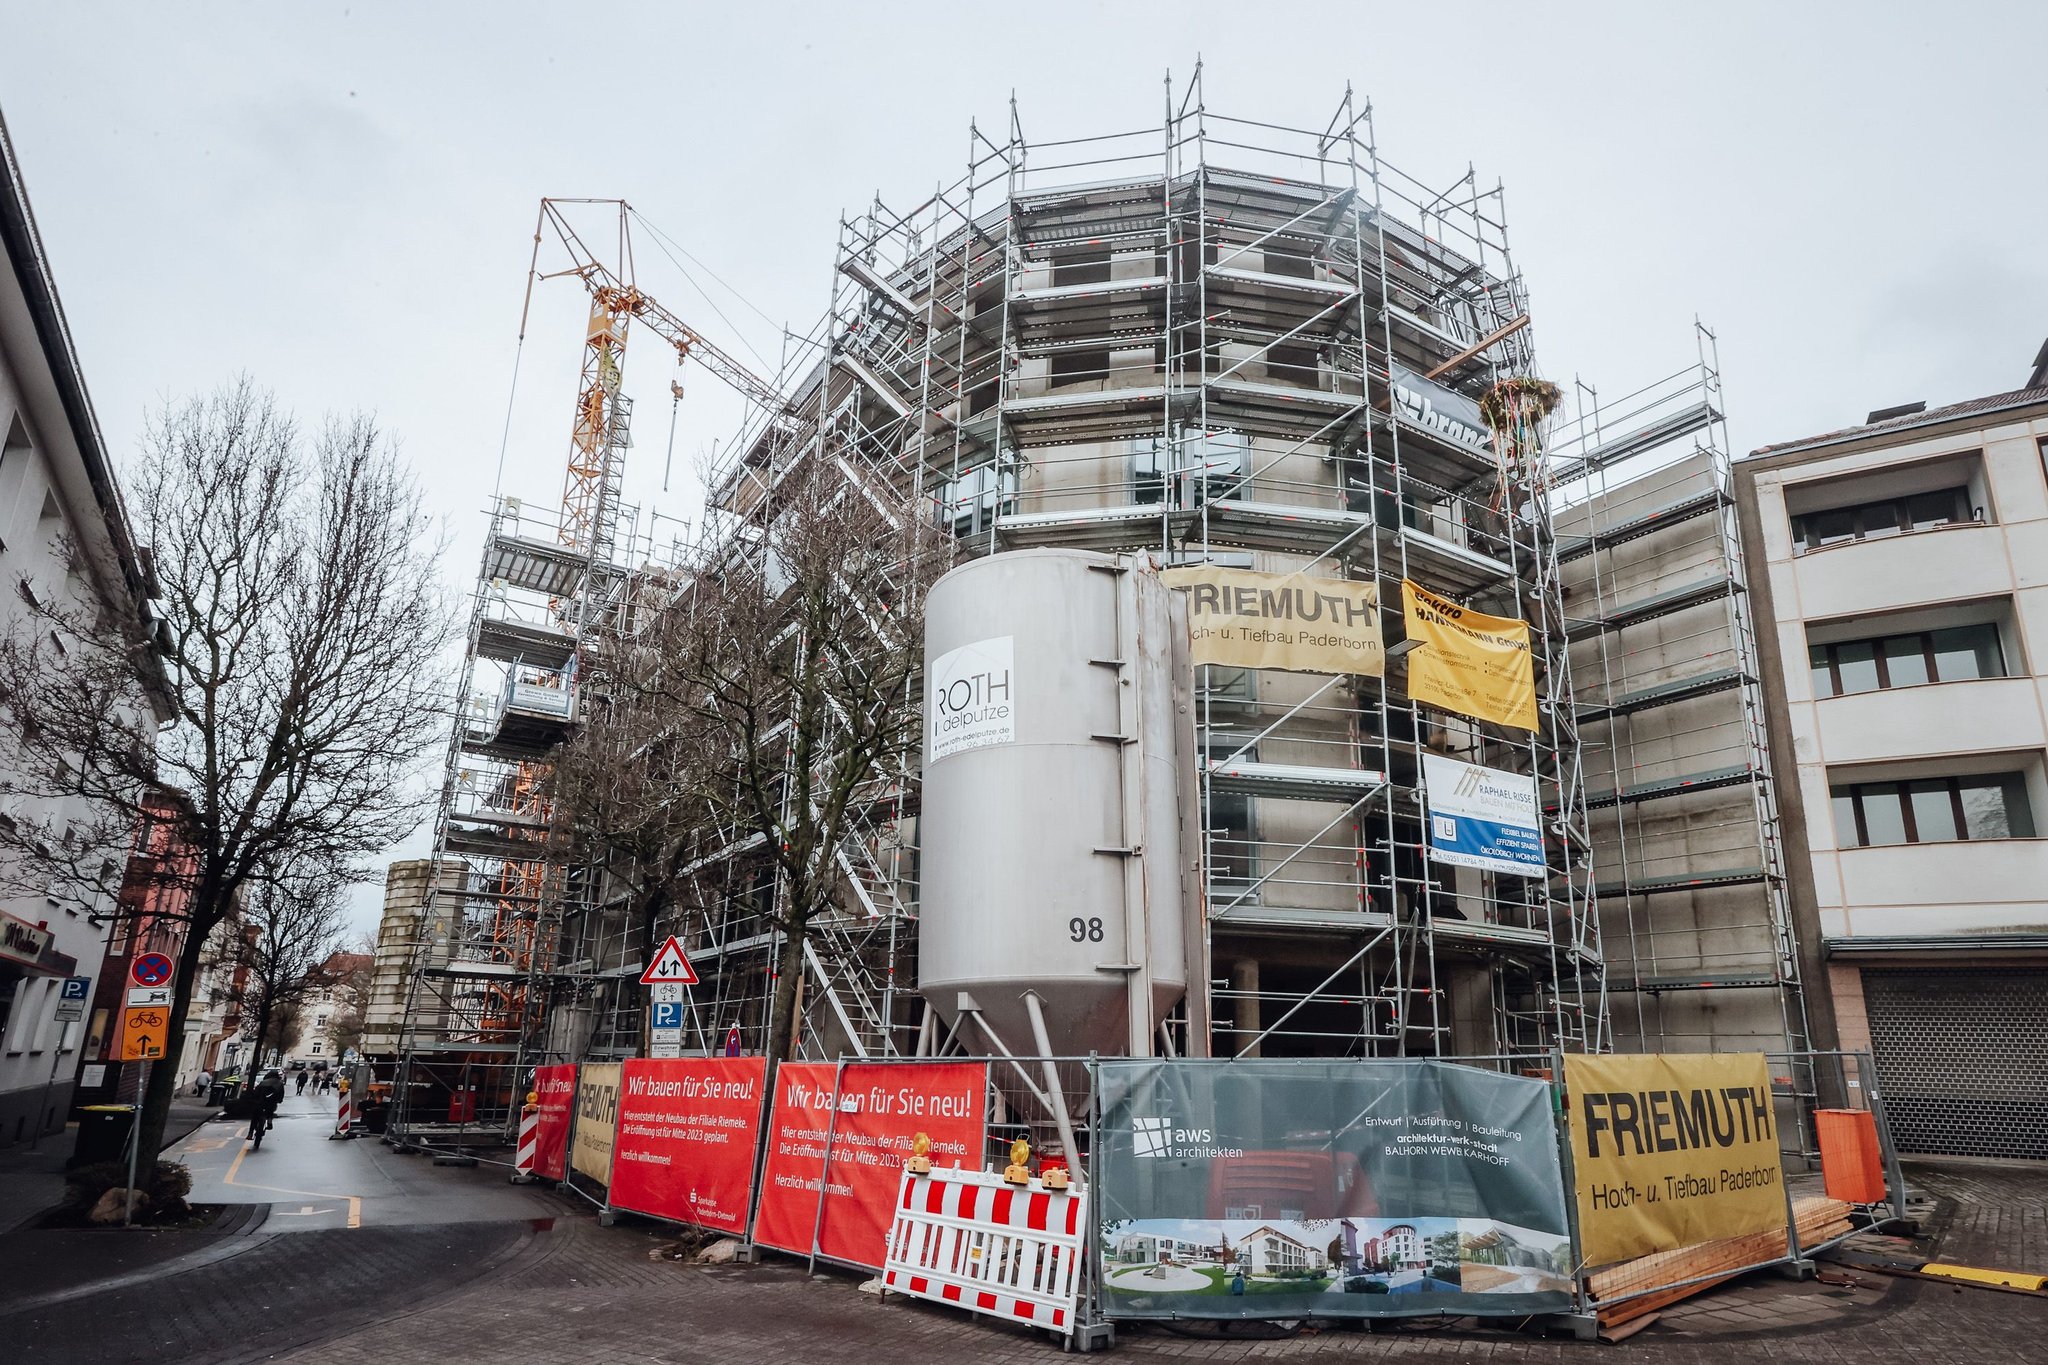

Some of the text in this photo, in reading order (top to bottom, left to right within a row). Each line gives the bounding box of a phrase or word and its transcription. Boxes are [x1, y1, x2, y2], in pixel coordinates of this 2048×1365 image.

[1174, 583, 1373, 627] RIEMUTH
[1221, 629, 1234, 640] u.
[1239, 627, 1293, 645] Tiefbau
[1299, 631, 1377, 651] Paderborn
[1479, 784, 1532, 804] RAPHAEL RISSE
[1069, 917, 1104, 943] 98
[65, 981, 82, 997] P
[656, 1003, 674, 1025] P
[628, 1076, 754, 1100] Wir bauen für Sie neu!
[787, 1084, 812, 1108] Wir
[869, 1086, 895, 1114] für
[897, 1088, 925, 1116] Sie
[929, 1089, 972, 1118] neu!
[623, 1110, 748, 1129] Hier entsteht der Neubau der Filiale Riemeke.
[1365, 1117, 1522, 1142] Entwurf Ausführung Bauleitung
[1582, 1085, 1772, 1159] FRIEMUTH
[630, 1124, 655, 1139] Eröffnung
[662, 1127, 671, 1138] für
[672, 1128, 686, 1139] Mitte
[687, 1129, 703, 1141] 2023
[704, 1131, 729, 1144] geplant.
[781, 1125, 797, 1138] Hier
[845, 1131, 876, 1147] Neubau
[877, 1134, 894, 1148] der
[894, 1136, 914, 1151] Filia
[1175, 1129, 1212, 1143] aws
[638, 1151, 672, 1166] willkommen!
[779, 1142, 791, 1155] Die
[840, 1148, 854, 1162] für
[855, 1150, 878, 1166] Mitte
[879, 1152, 901, 1168] 2023
[1175, 1146, 1243, 1158] architekten
[1385, 1146, 1428, 1156] BALHORN
[1464, 1148, 1510, 1167] KARHOFF
[774, 1173, 804, 1189] Herzlich
[1591, 1181, 1642, 1210] Hoch-
[1647, 1184, 1661, 1203] u.
[1664, 1173, 1716, 1201] Tiefbau
